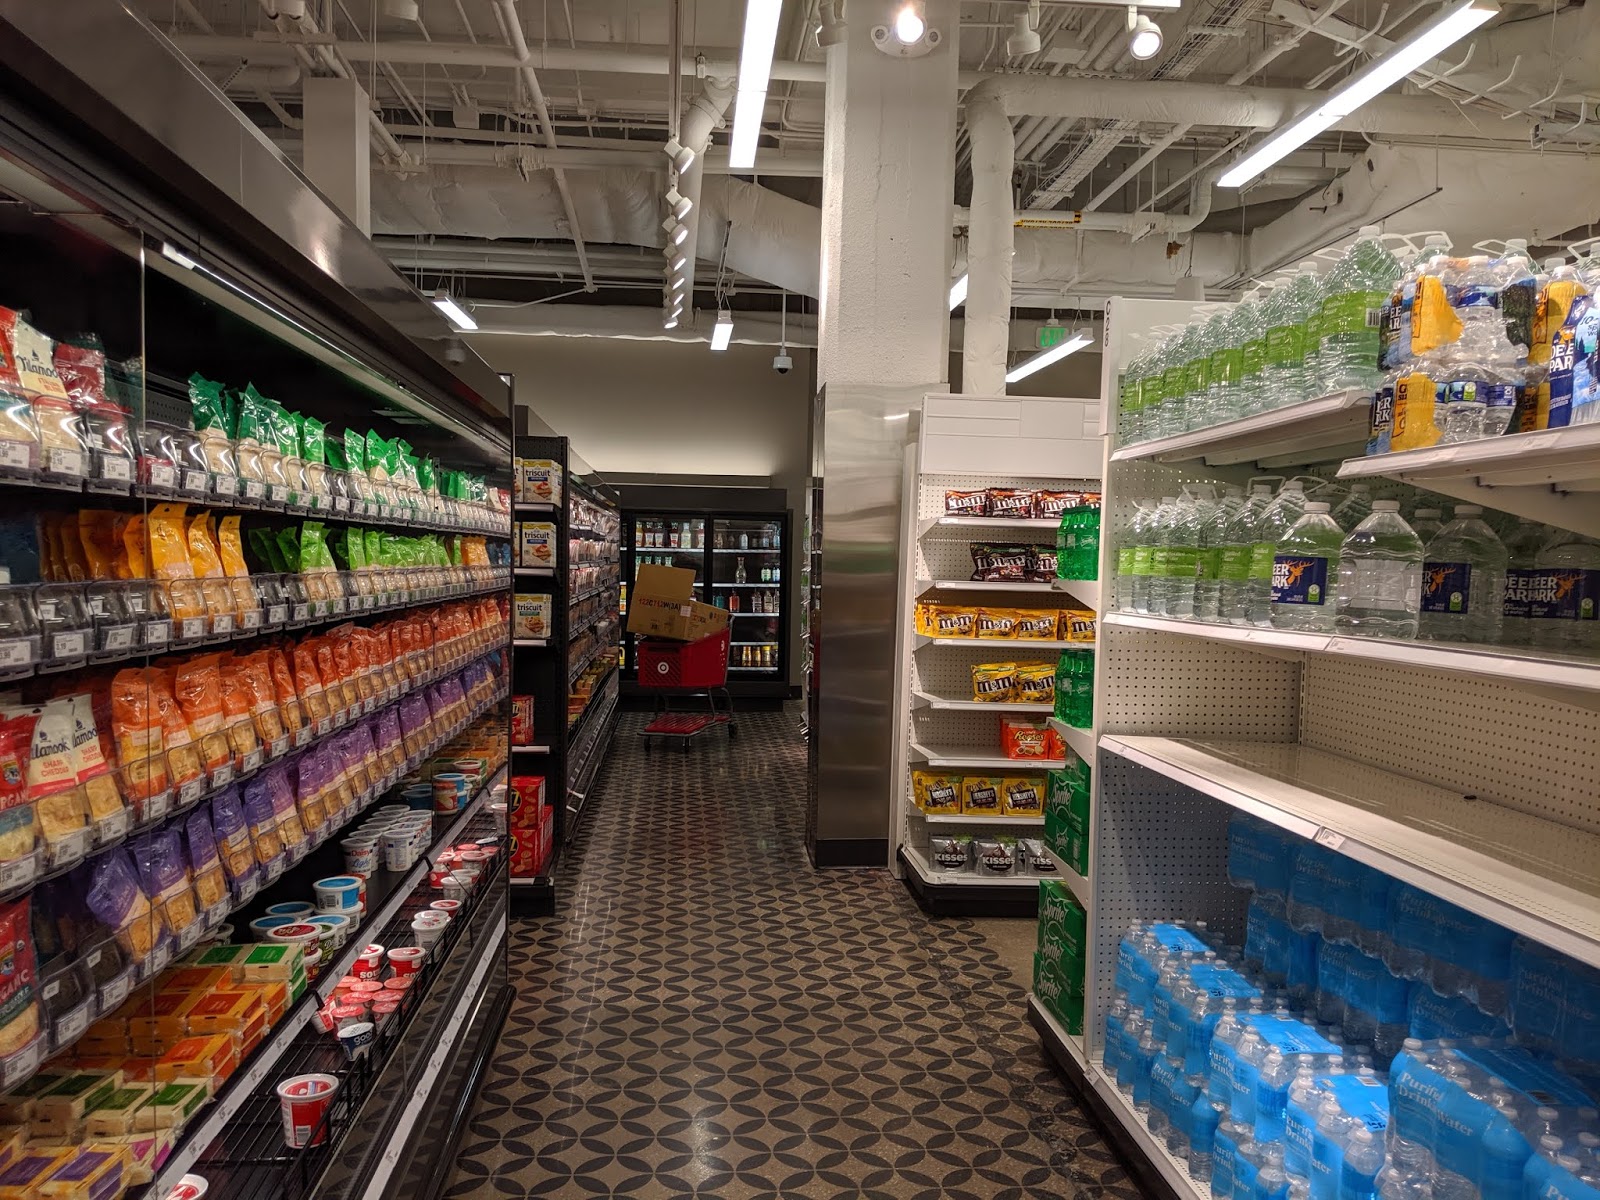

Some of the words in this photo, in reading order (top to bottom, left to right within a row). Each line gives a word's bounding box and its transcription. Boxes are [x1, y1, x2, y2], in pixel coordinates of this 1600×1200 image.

[1551, 342, 1574, 360] DEE
[1550, 355, 1574, 374] PAR
[525, 469, 551, 477] triscuit
[524, 531, 550, 539] triscuit
[1273, 564, 1289, 575] EER
[517, 604, 542, 612] triscuit
[1052, 783, 1071, 807] Sprite
[1043, 897, 1065, 922] Sprite
[1039, 971, 1060, 999] Sprite
